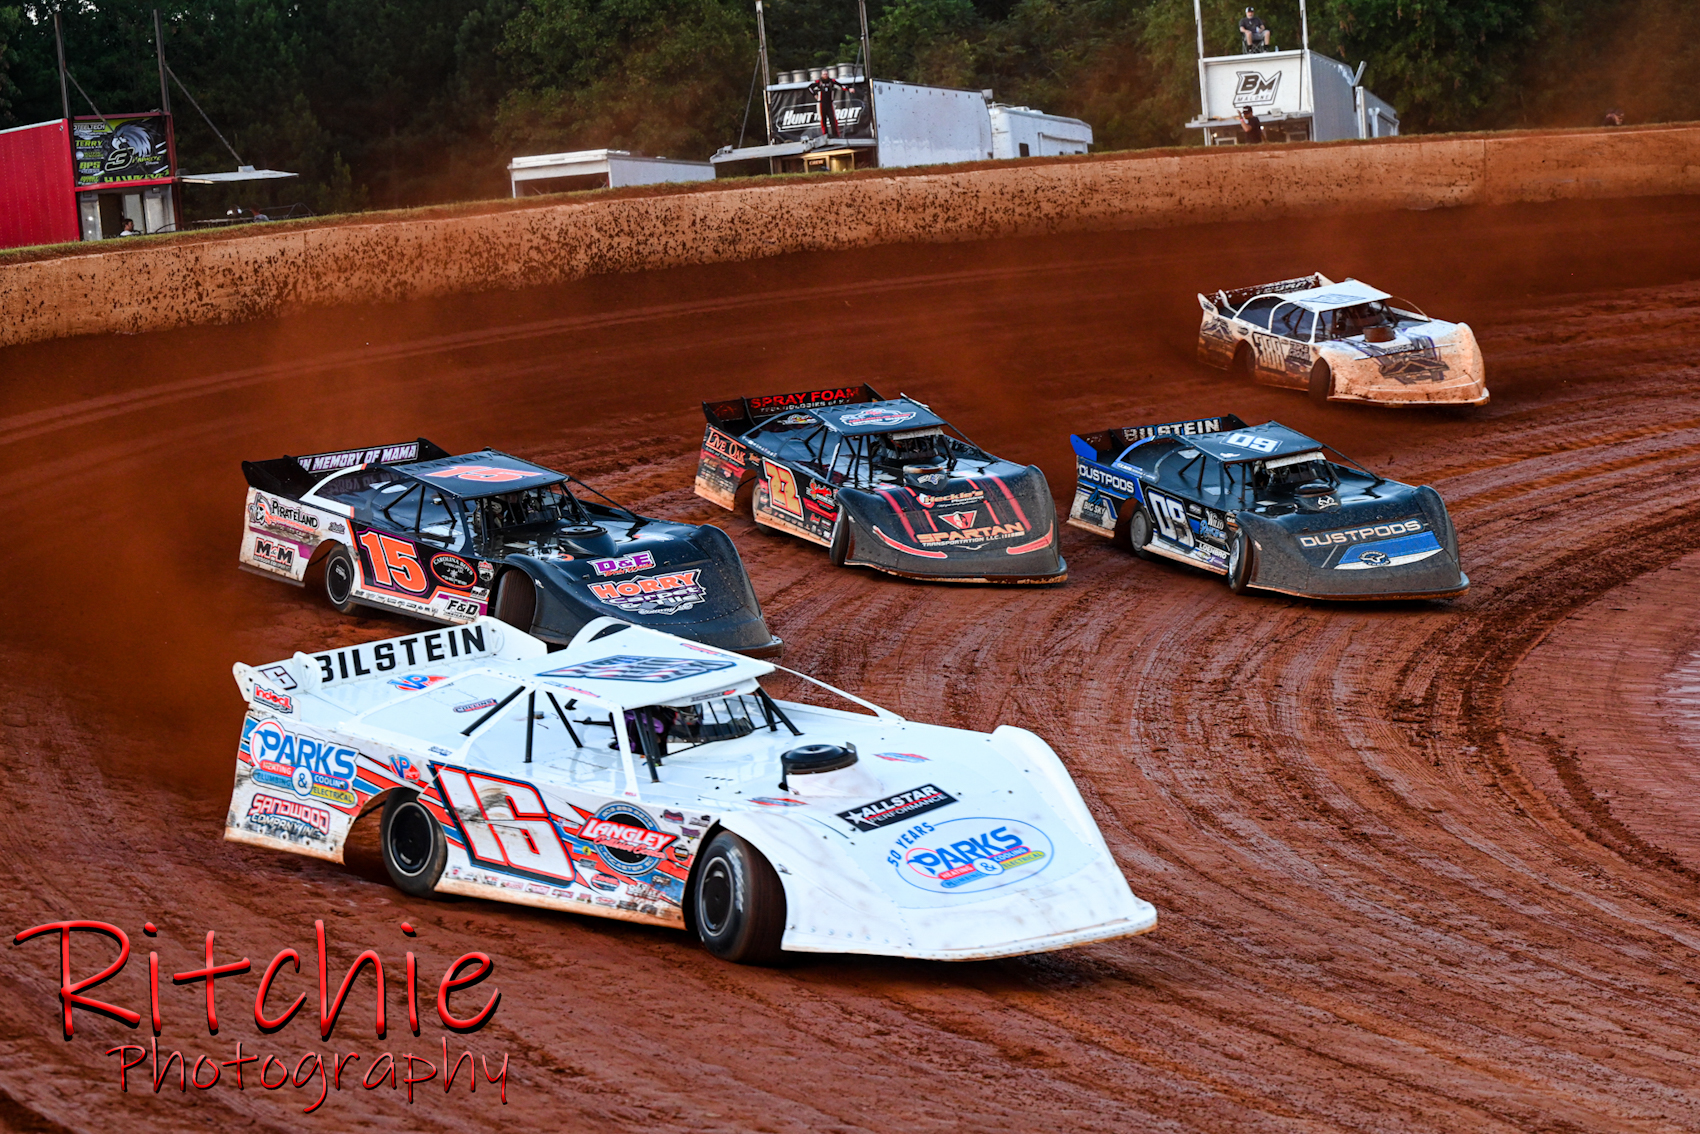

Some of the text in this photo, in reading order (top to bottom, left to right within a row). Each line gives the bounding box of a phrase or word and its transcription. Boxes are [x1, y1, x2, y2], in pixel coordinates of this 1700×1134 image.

[1240, 75, 1276, 95] BM
[783, 110, 814, 126] HUNT
[835, 107, 862, 120] RONT
[751, 387, 860, 409] SPRAY FOAM
[1123, 418, 1221, 442] BILSTEIN
[1226, 432, 1280, 453] 09
[312, 454, 362, 470] MEMORY
[364, 449, 381, 462] OF
[381, 444, 419, 461] MAMA
[706, 430, 727, 452] LIVE
[729, 442, 746, 464] OAK
[425, 465, 543, 482] 15
[1079, 464, 1135, 494] DUSTPODS
[916, 521, 1025, 543] SPARTAN
[1147, 490, 1196, 550] 09
[1299, 520, 1422, 547] DUSTPODS
[256, 540, 293, 564] M&M
[922, 537, 984, 547] TRANSPORTATION
[1199, 543, 1228, 560] LOENBRO
[360, 531, 427, 592] 15
[595, 553, 652, 572] D&E
[592, 571, 696, 599] HORRY
[447, 600, 479, 616] F&D
[313, 625, 487, 683] BILSTEIN
[254, 729, 357, 780] PARKS
[262, 761, 292, 776] HEATING
[314, 775, 346, 789] COOLING
[313, 786, 353, 804] ELECTRICAL
[861, 785, 939, 818] ALLSTAR
[868, 793, 948, 823] PERFORMANCE
[248, 793, 330, 836] SANDWOOD
[251, 812, 298, 831] COMPANY
[434, 763, 576, 883] 16
[581, 819, 672, 851] LANGLEY
[887, 822, 936, 868] 50 YEARS
[906, 826, 1024, 875] PARKS
[941, 864, 975, 879] HEATING
[994, 846, 1028, 862] COOLING
[1002, 852, 1042, 868] ELECTRICAL
